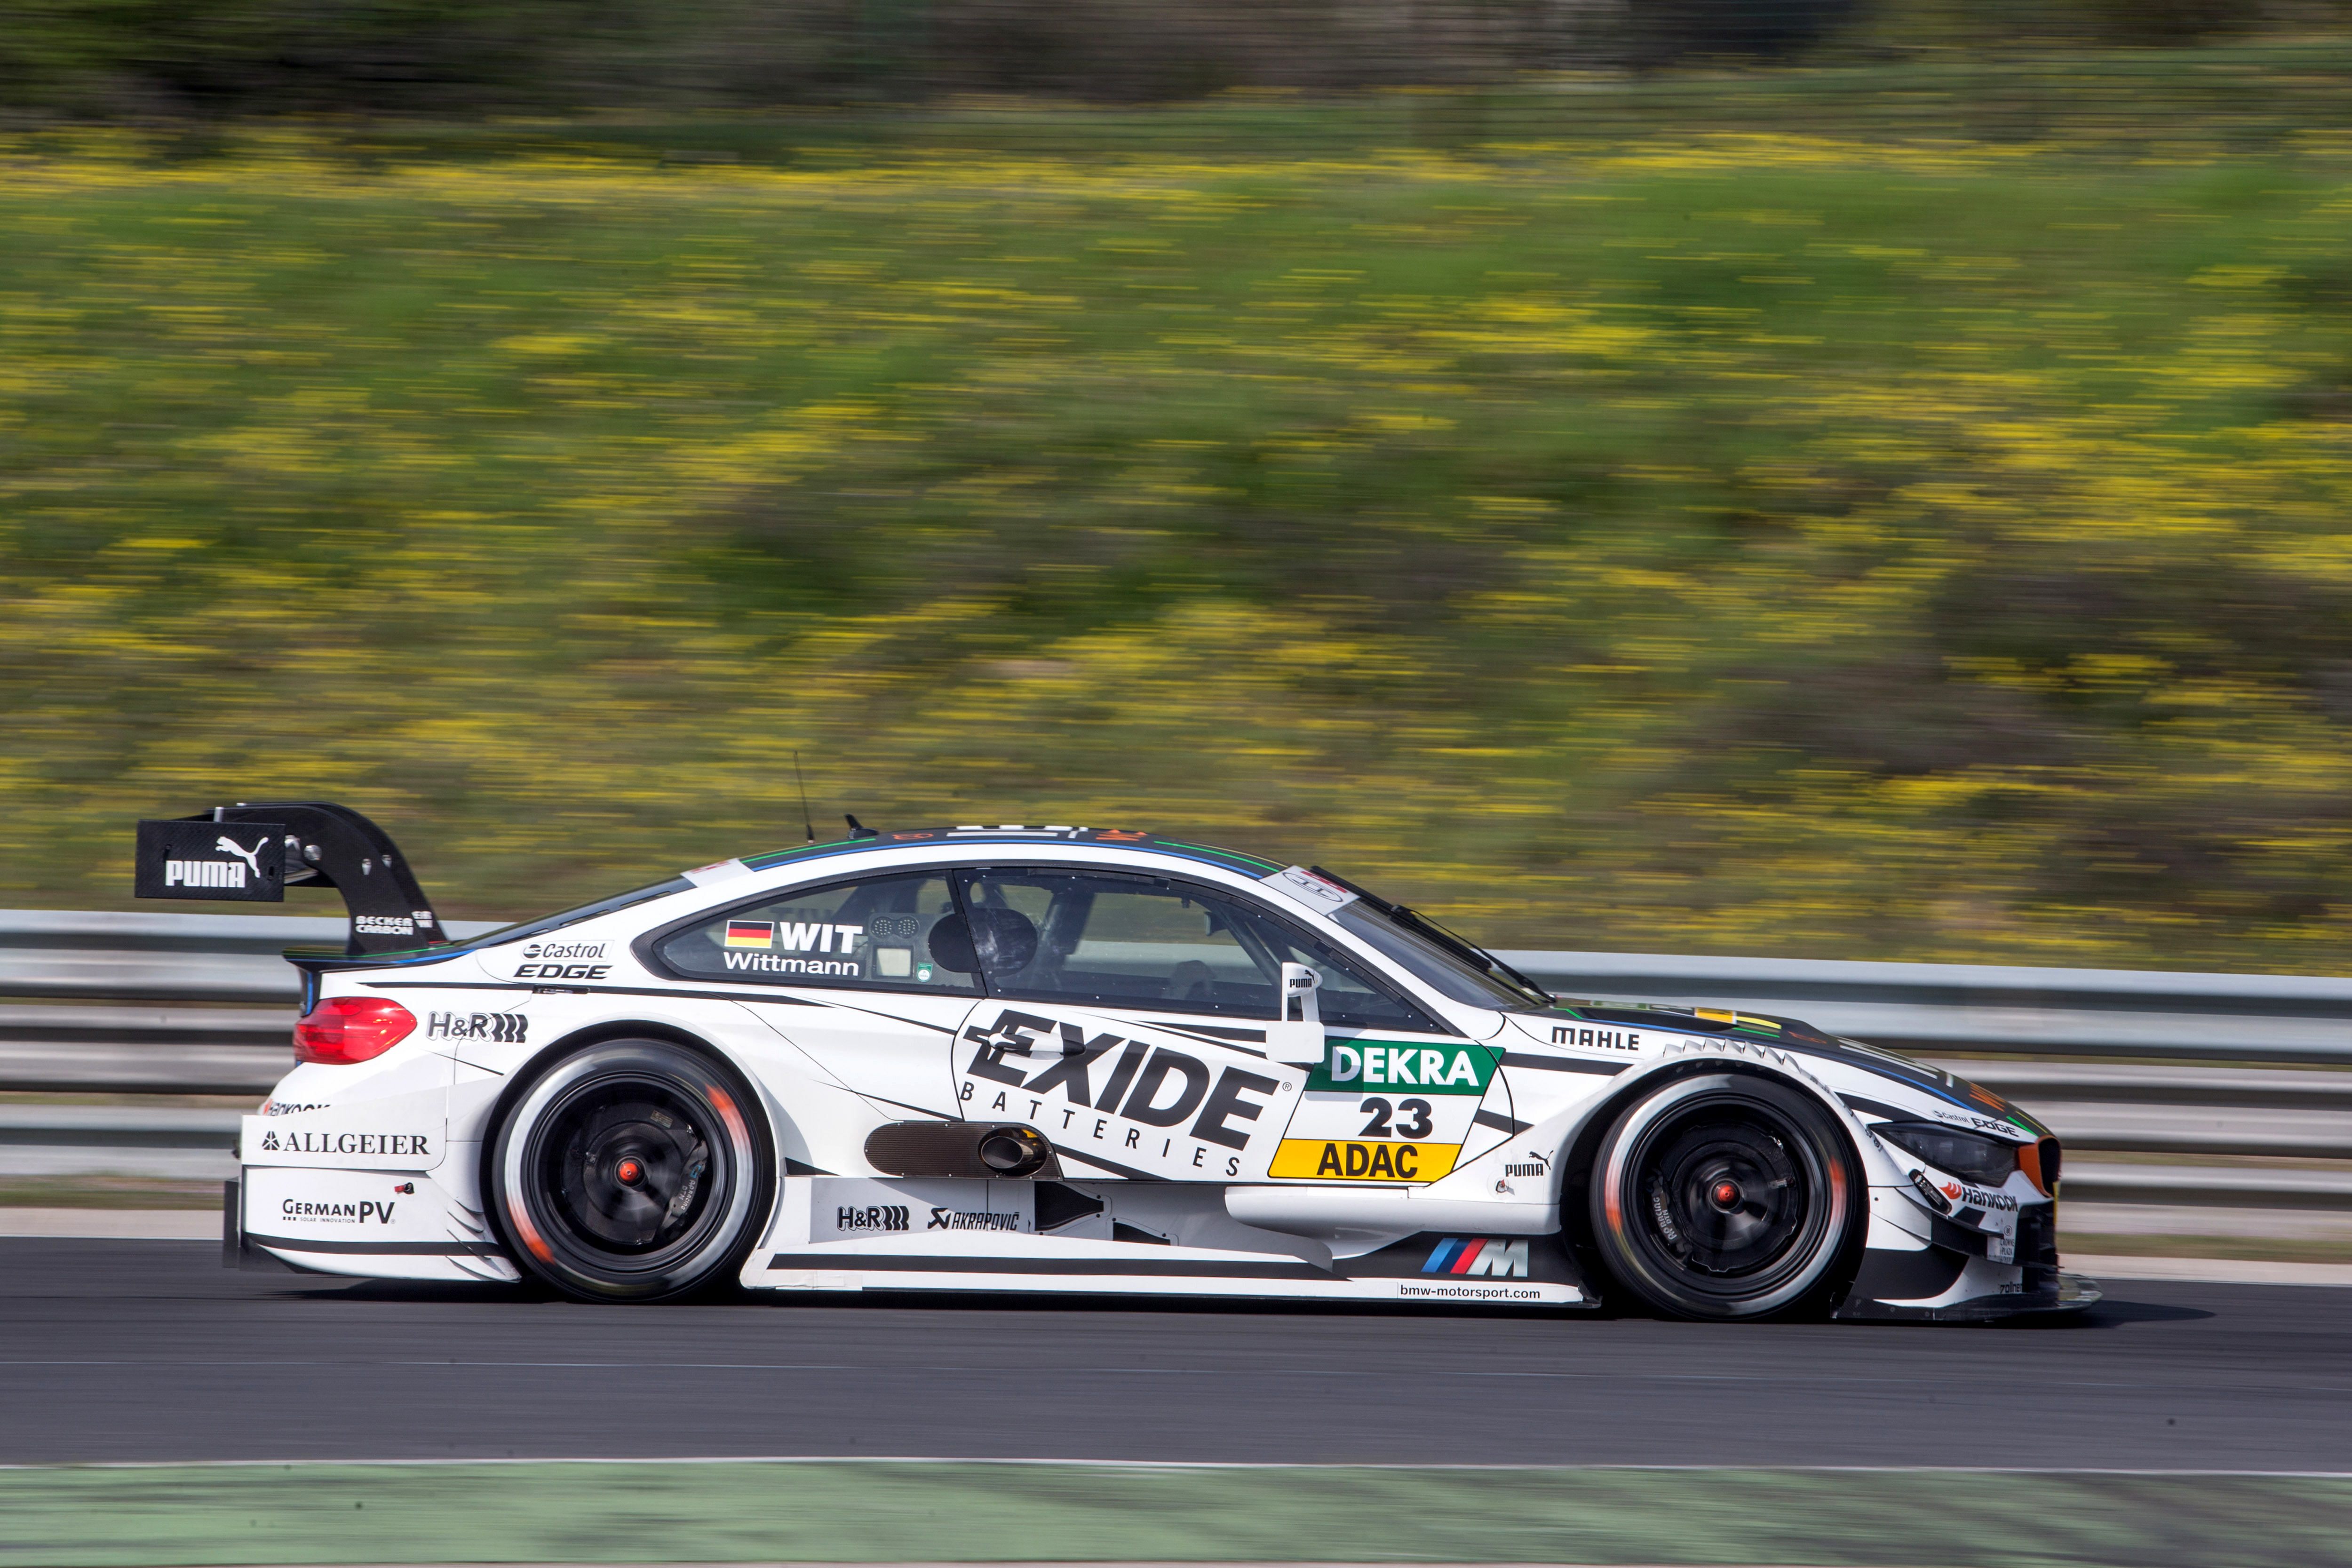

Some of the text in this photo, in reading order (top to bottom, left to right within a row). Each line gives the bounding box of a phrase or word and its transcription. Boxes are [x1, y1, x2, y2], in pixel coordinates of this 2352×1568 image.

[166, 860, 246, 888] PUMA
[355, 924, 413, 935] CARBON
[356, 915, 413, 926] BECKER
[543, 943, 605, 958] Castrol
[779, 922, 863, 954] WIT
[513, 964, 613, 979] EDGE
[723, 952, 858, 976] Wittmann
[1290, 978, 1312, 987] PUMA
[427, 1012, 491, 1041] H&R
[1552, 1026, 1639, 1051] MAHLE
[1332, 1046, 1478, 1086] DEKRA
[963, 1009, 1280, 1151] EXIDE
[960, 1082, 1240, 1176] BATTERIES
[1359, 1097, 1433, 1139] 23
[1942, 1112, 2018, 1137] Castrol EDGE
[284, 1132, 430, 1154] ALLGEIER
[1317, 1143, 1418, 1178] ADAC
[1505, 1163, 1543, 1177] PUMA
[837, 1206, 882, 1231] H&R
[1400, 1285, 1541, 1299] bmw-motorsport.com
